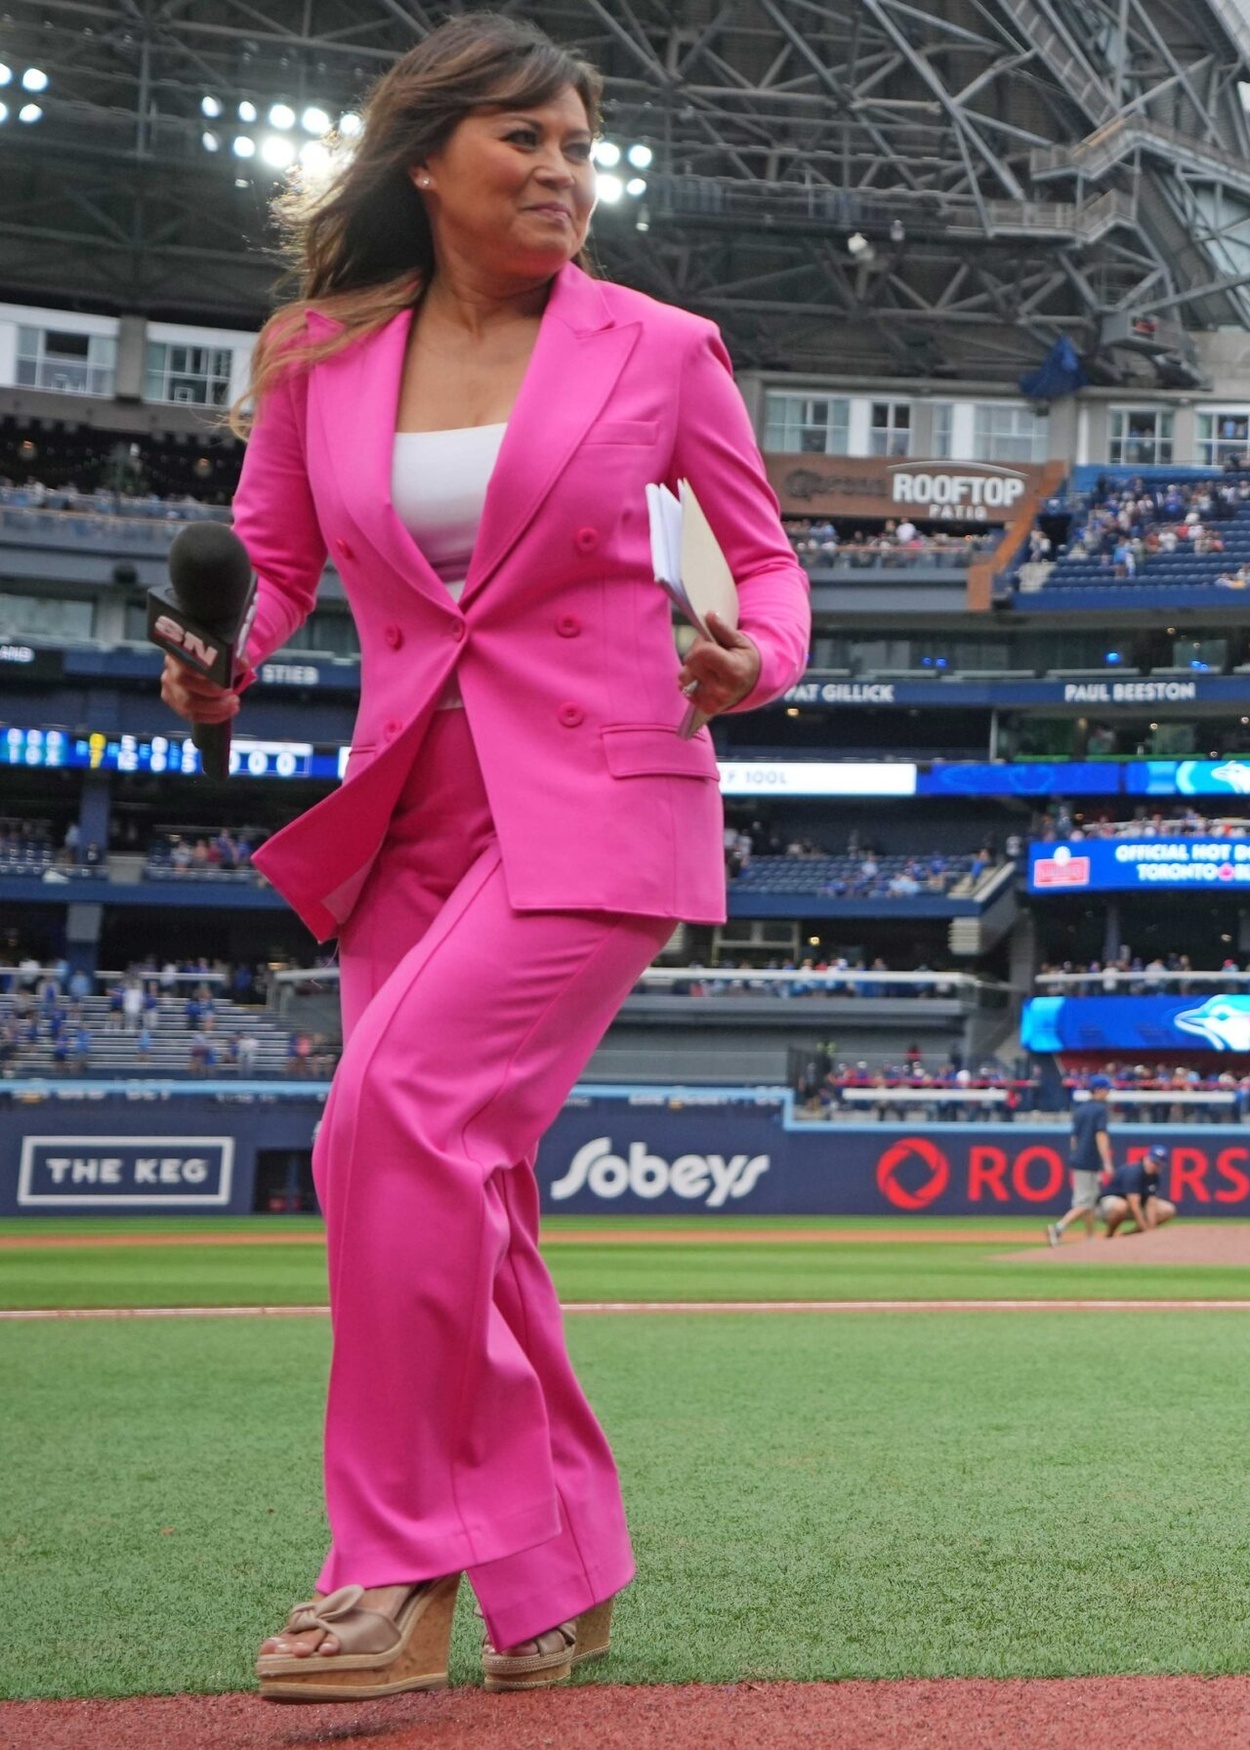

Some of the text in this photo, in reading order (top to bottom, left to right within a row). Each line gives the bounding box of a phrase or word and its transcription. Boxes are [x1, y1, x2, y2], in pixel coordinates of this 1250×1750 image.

[893, 473, 1024, 506] ROOFTOP
[928, 504, 987, 520] PATIO
[261, 664, 319, 685] STIEB
[784, 683, 895, 702] PAT GILLICK
[1065, 682, 1196, 702] PAUL BEESTON
[1115, 844, 1189, 862] OFFICIAL
[1191, 844, 1231, 861] HOT
[1136, 863, 1219, 881] TORONTO
[46, 1158, 207, 1183] THE KEG
[551, 1136, 770, 1207] Sobeys
[968, 1146, 1250, 1203] RORS
